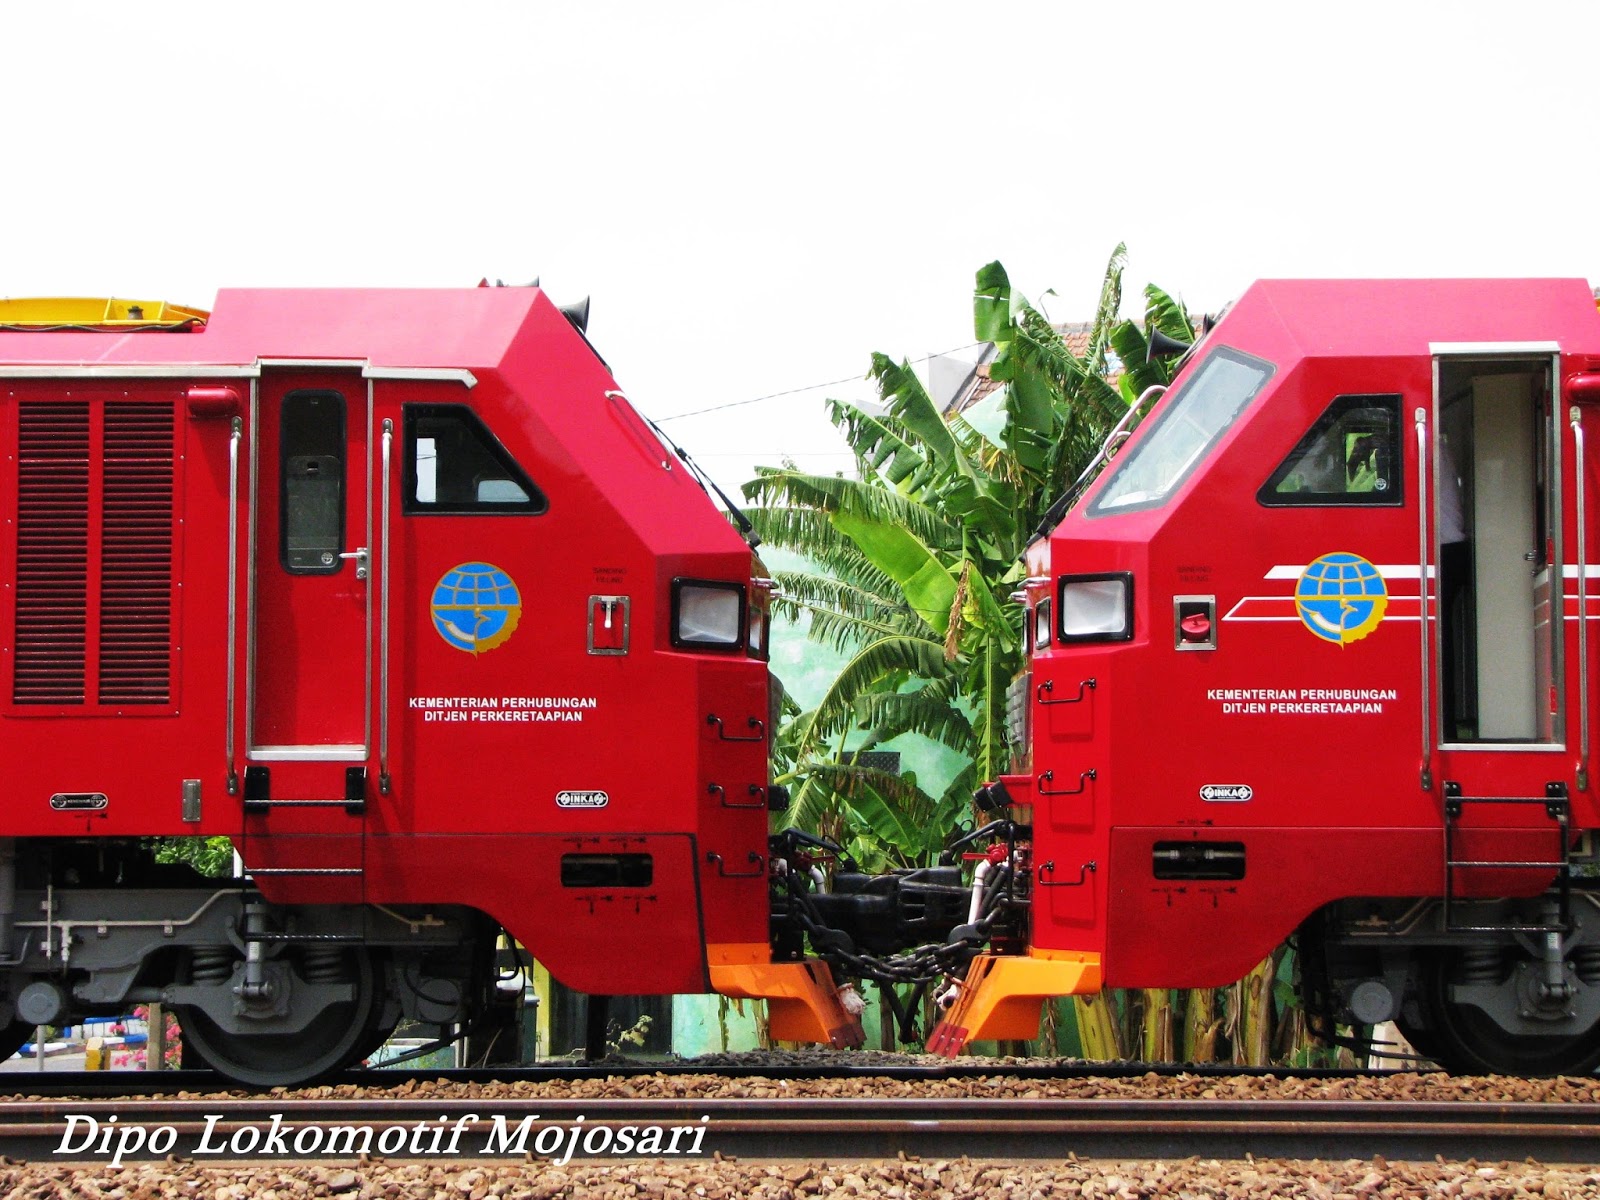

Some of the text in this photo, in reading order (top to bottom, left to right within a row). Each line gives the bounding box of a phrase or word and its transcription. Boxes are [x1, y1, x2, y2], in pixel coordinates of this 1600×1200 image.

[1207, 689, 1397, 700] KEMENTERIAN PERHUBUNGAN
[409, 697, 597, 708] KEMENTERIAN PERHUBUNGAN
[1222, 702, 1382, 714] DITJEN PERKERETAAPIAN
[424, 710, 582, 722] DITJEN PERKERETAAPIAN
[1214, 788, 1238, 797] INKA
[570, 794, 594, 803] INKA
